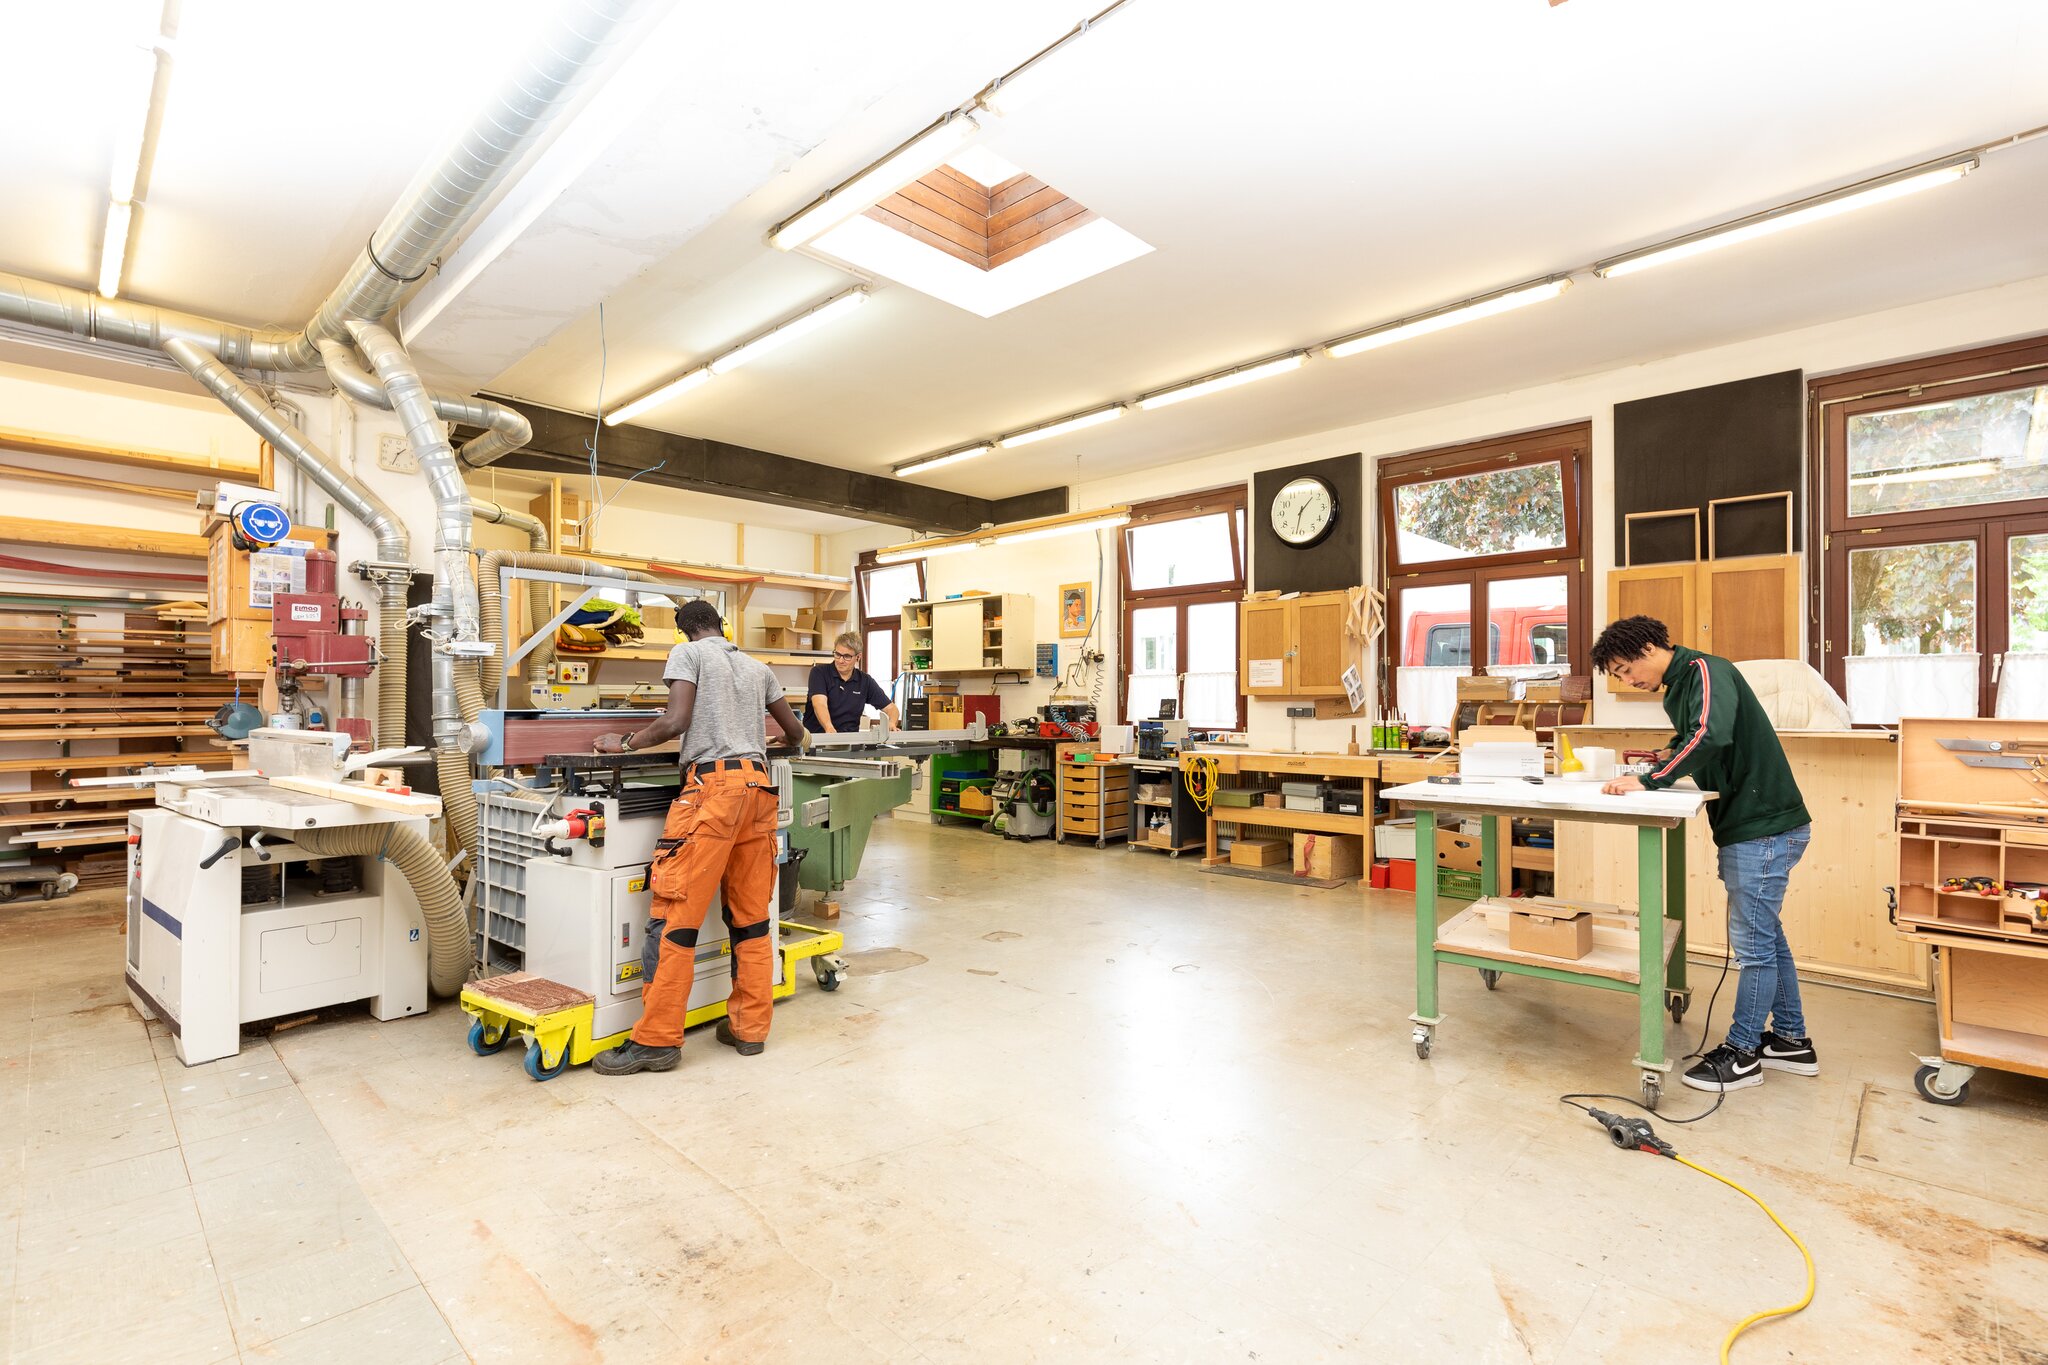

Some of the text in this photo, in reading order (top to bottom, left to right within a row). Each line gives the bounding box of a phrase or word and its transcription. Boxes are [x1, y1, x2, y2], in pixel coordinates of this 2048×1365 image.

[1320, 503, 1326, 511] 3
[1279, 510, 1285, 518] 9
[1316, 514, 1321, 522] 4
[1282, 520, 1288, 528] 8
[1311, 523, 1315, 532] 5
